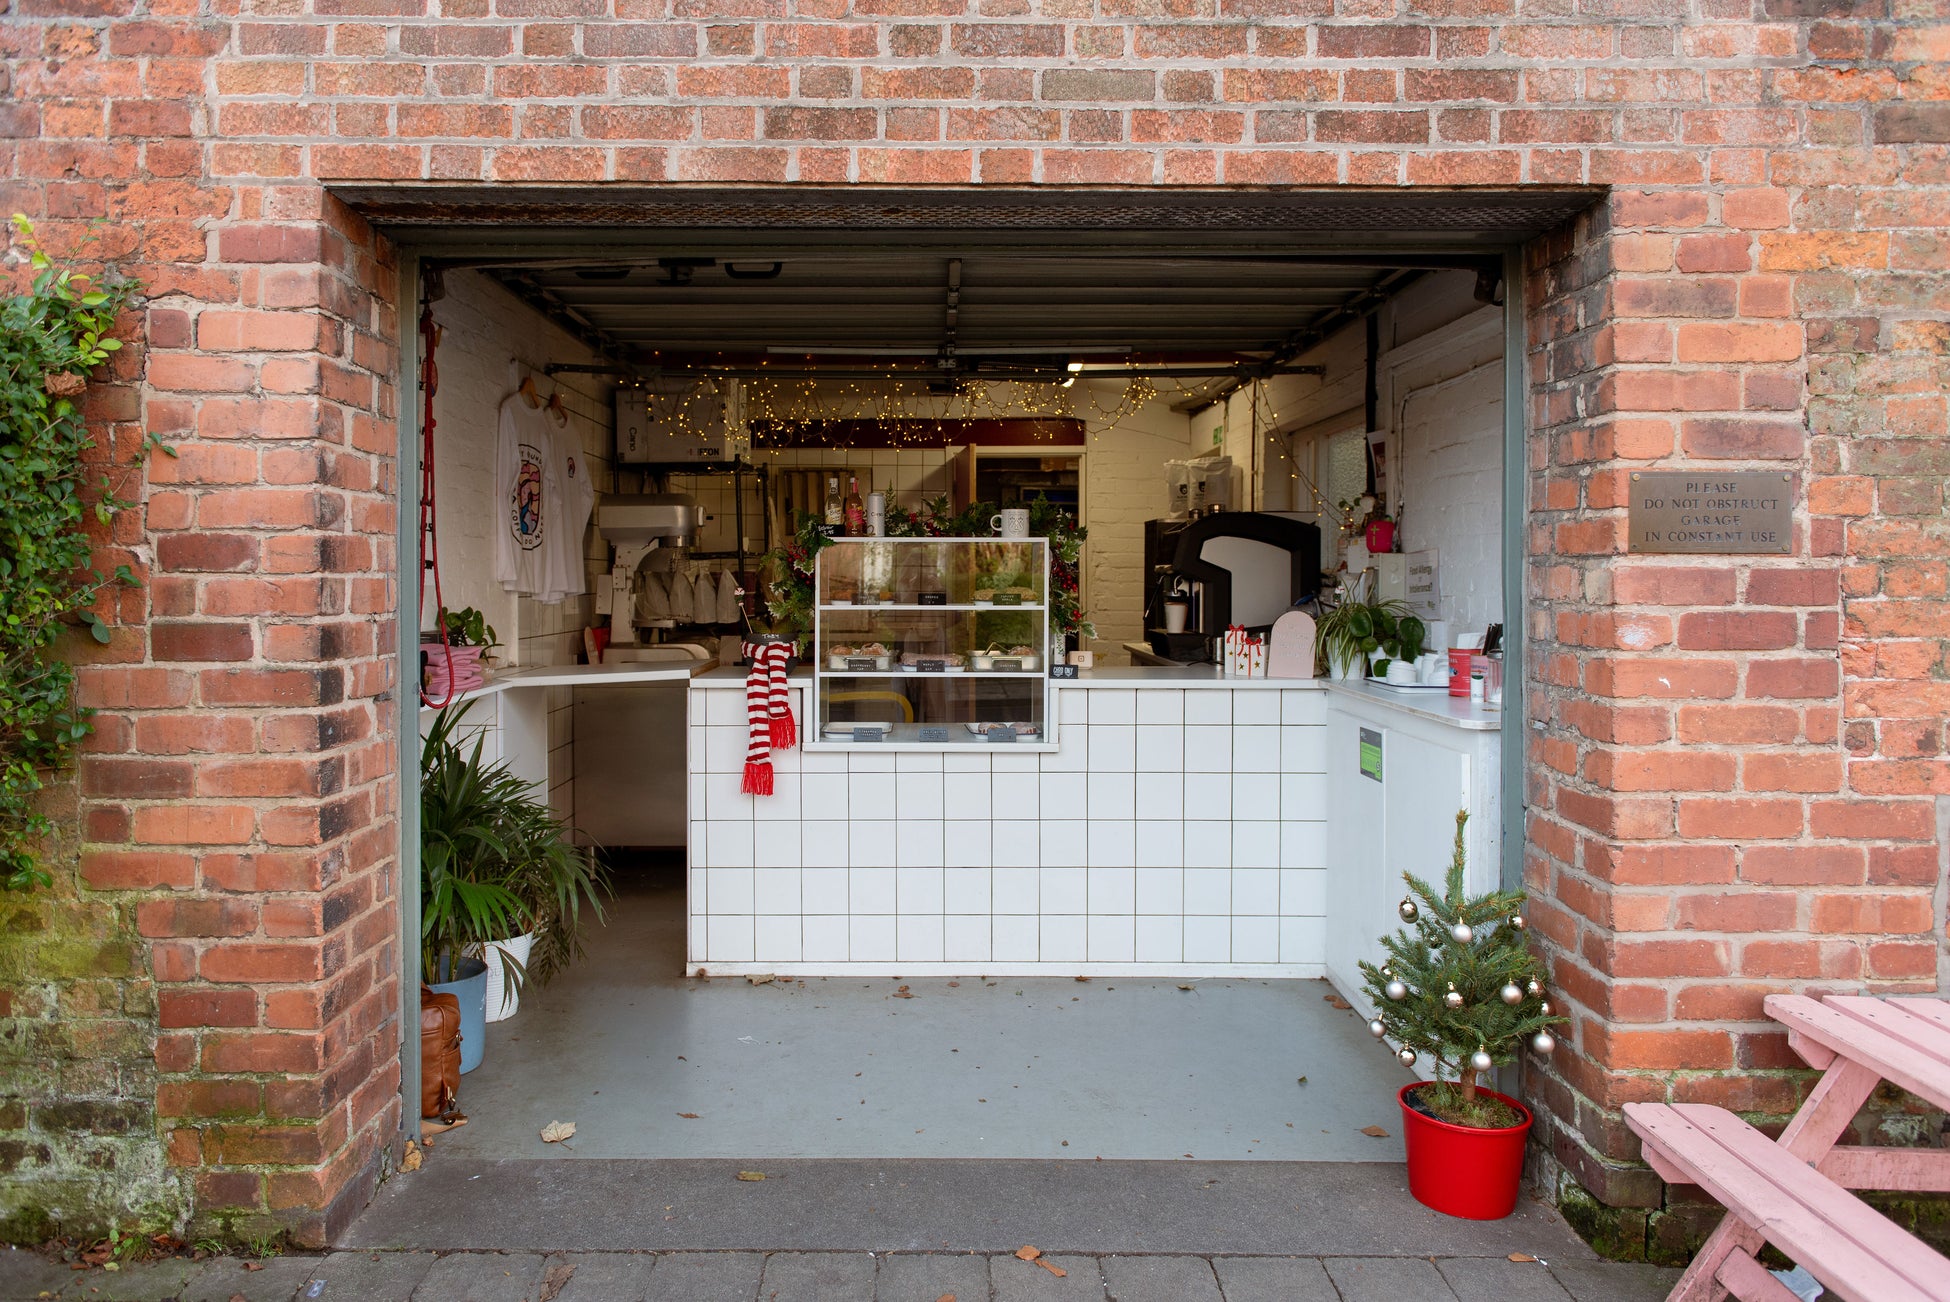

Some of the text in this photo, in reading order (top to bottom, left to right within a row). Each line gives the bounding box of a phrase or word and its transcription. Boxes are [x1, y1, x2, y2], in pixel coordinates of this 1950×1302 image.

[1686, 482, 1737, 493] PLEASE
[1644, 499, 1778, 510] DO NOT OBSTRUCT
[1681, 515, 1741, 526] GARAGE
[1644, 531, 1777, 542] IN CONSTANT USE
